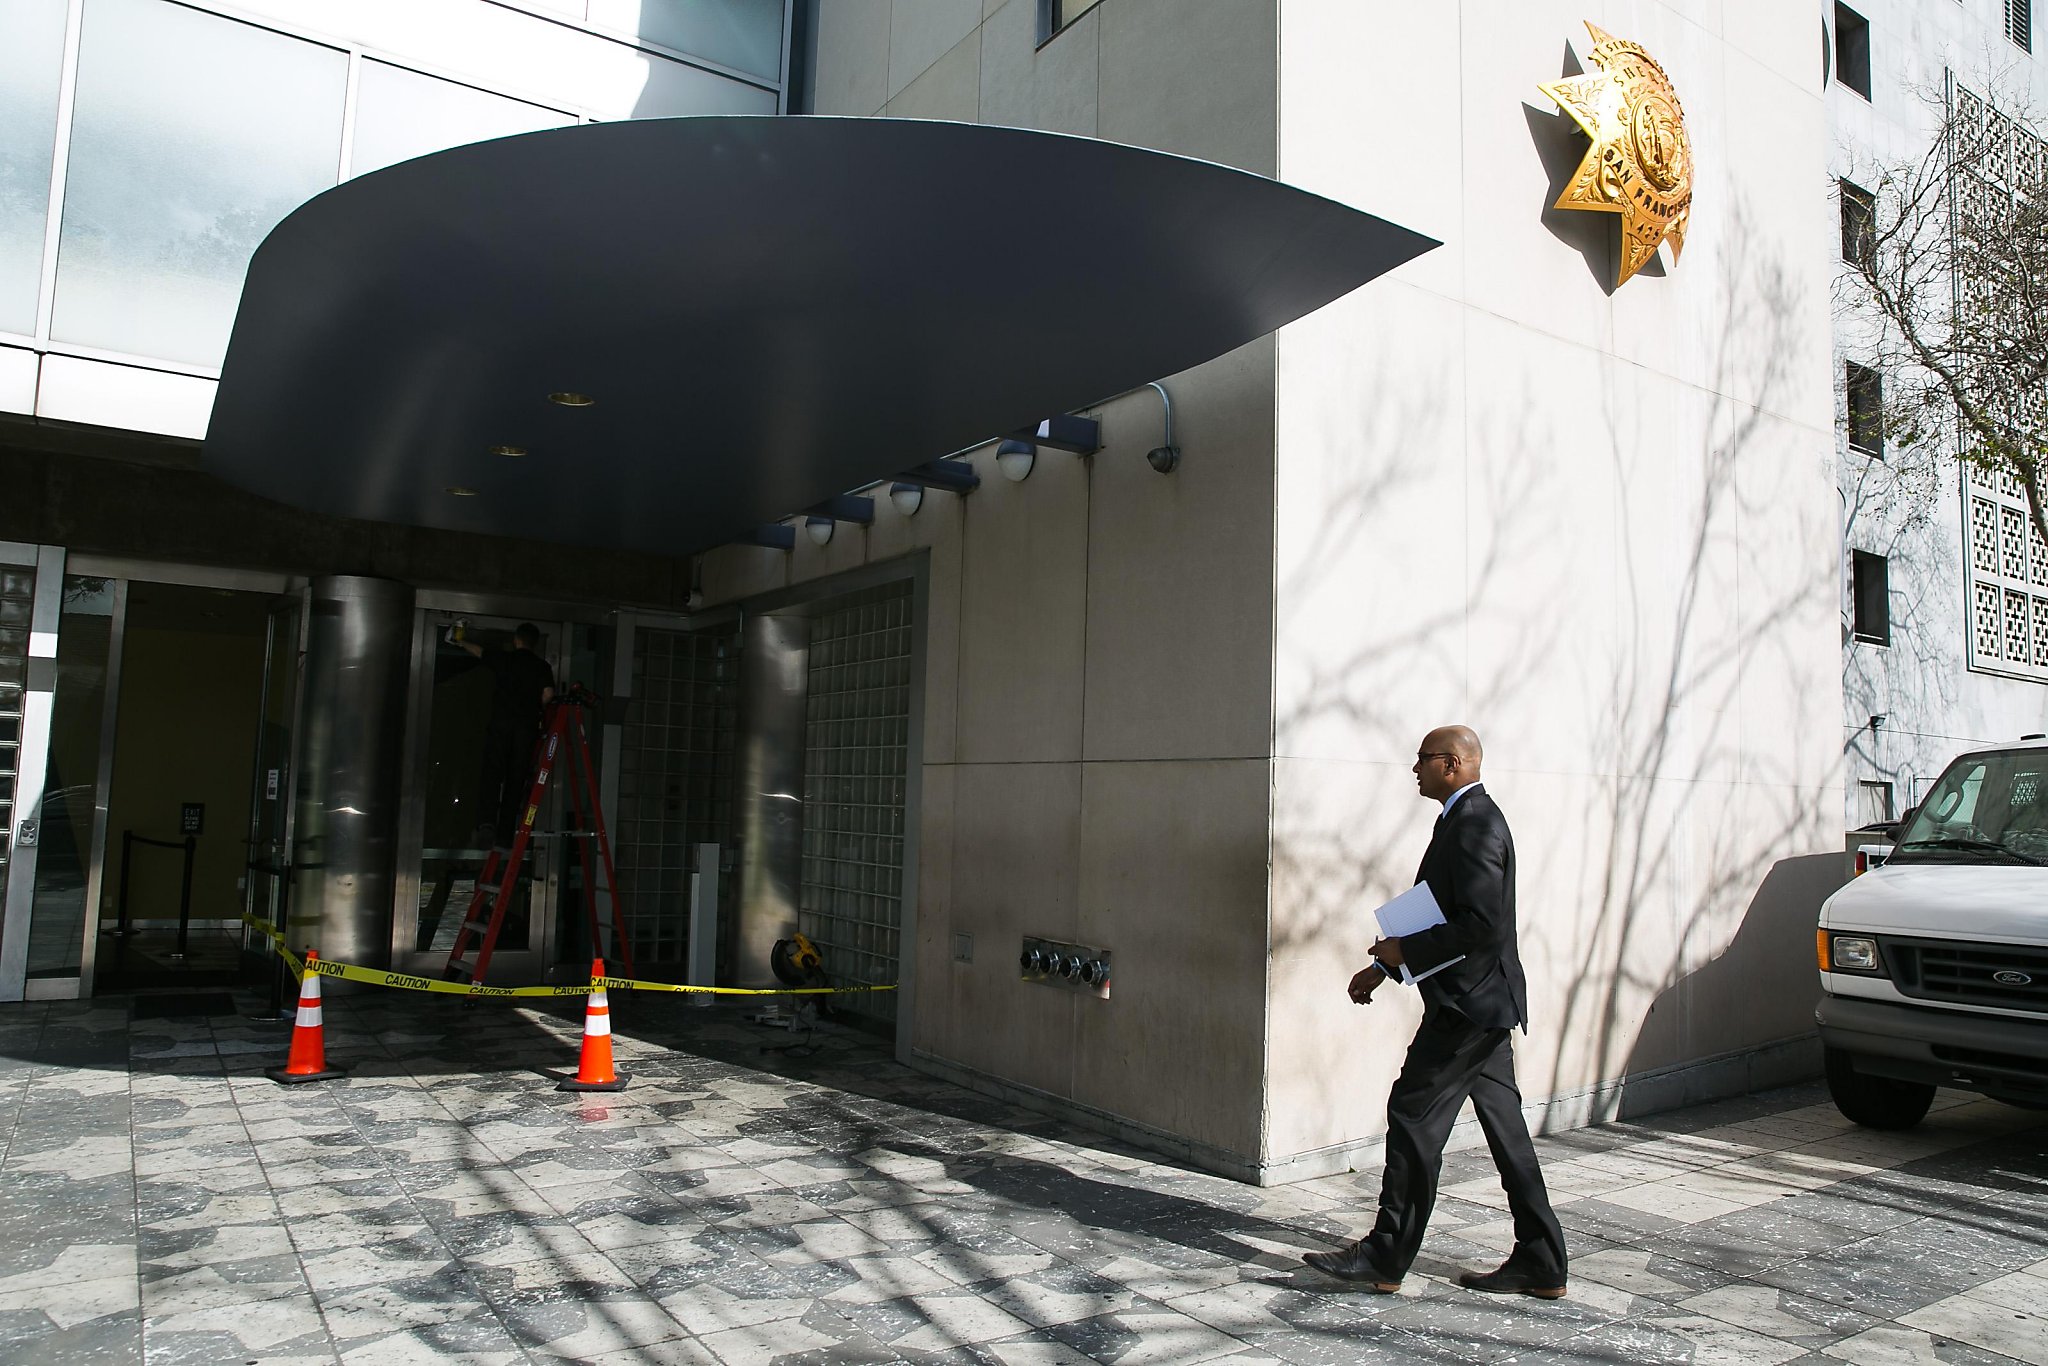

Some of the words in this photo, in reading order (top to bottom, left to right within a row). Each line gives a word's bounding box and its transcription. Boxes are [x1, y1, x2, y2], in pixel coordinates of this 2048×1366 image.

[1606, 40, 1646, 54] SINCE
[1603, 148, 1633, 185] SAN
[385, 973, 431, 990] CAUTION
[469, 986, 516, 995] CAUTION
[591, 976, 635, 990] CAUTION
